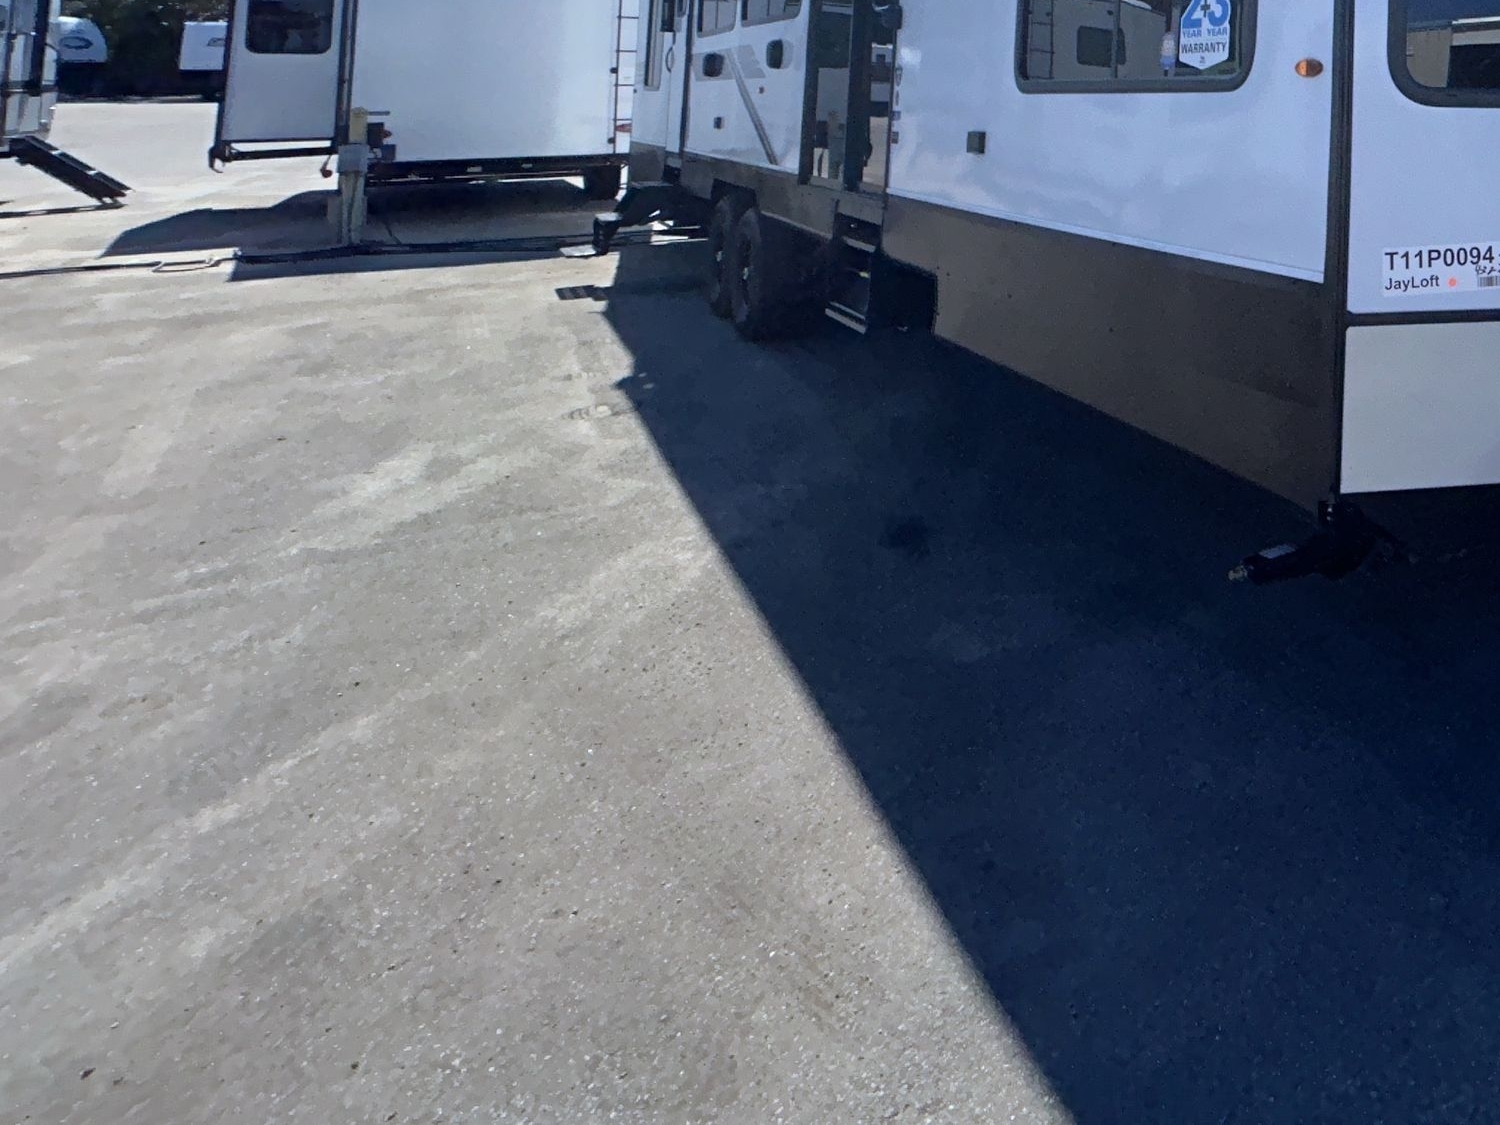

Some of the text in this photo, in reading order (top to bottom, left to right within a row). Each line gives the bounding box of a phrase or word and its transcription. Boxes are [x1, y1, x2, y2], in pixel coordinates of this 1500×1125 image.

[1183, 26, 1229, 38] YEAR YEAR
[1181, 41, 1228, 54] WARRANTY
[1384, 245, 1495, 271] T11P0094
[1384, 274, 1440, 292] JayLoft
